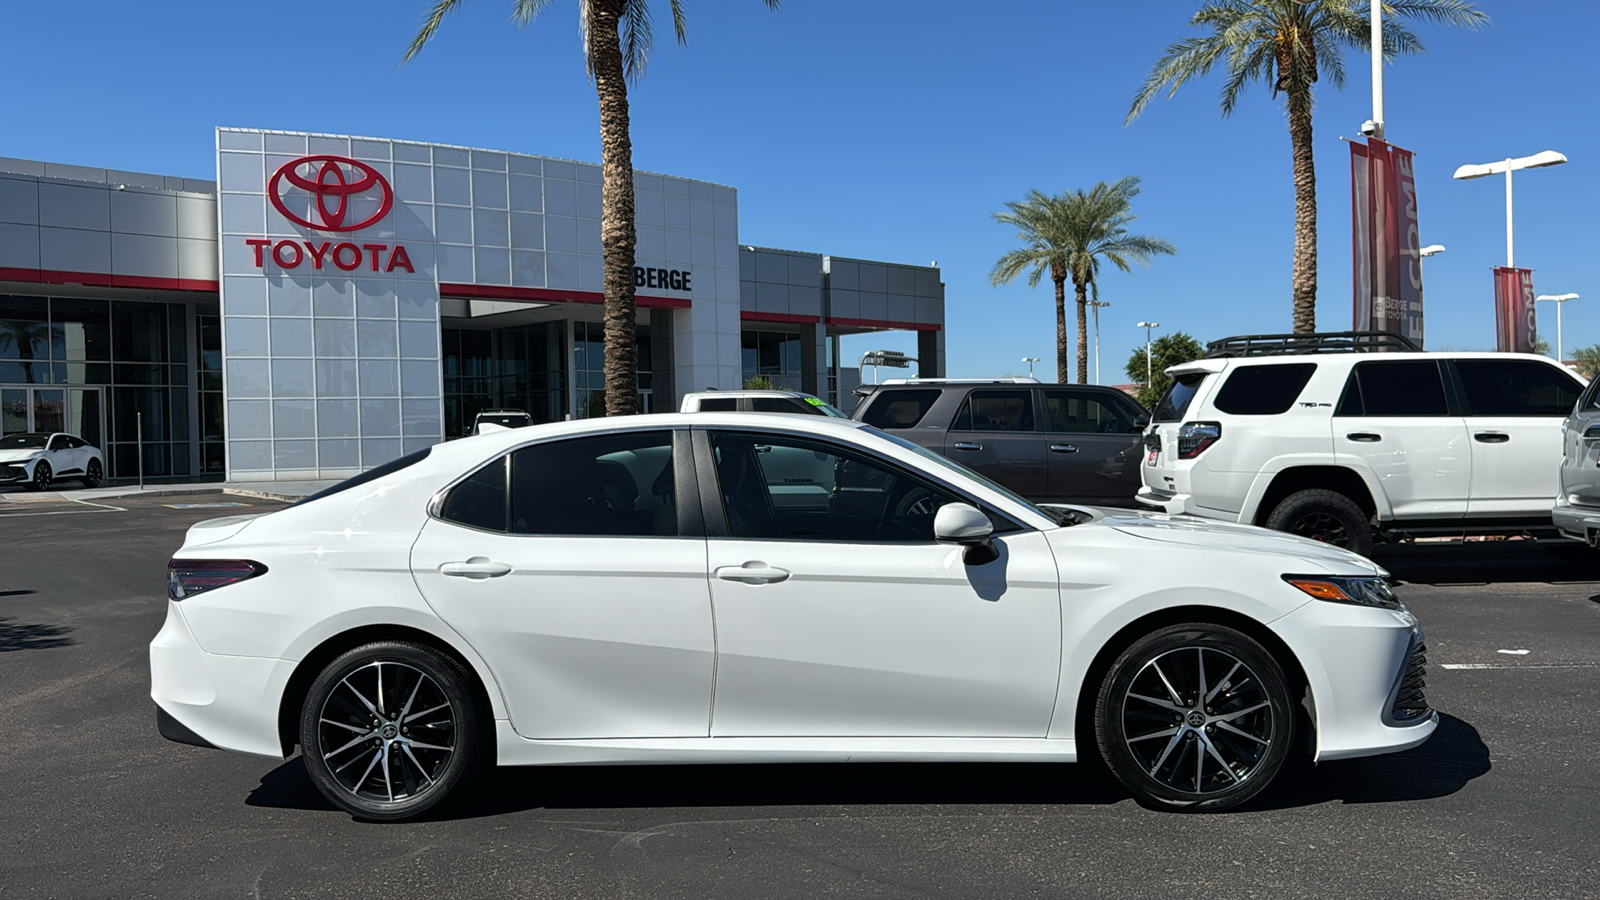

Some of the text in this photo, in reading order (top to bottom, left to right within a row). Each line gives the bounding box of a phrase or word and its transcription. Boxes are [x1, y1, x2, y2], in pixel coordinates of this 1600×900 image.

[246, 239, 415, 273] TOYOTA
[1399, 153, 1423, 339] ELCOME
[634, 267, 692, 291] BERGE
[1385, 310, 1408, 320] TOYOTA
